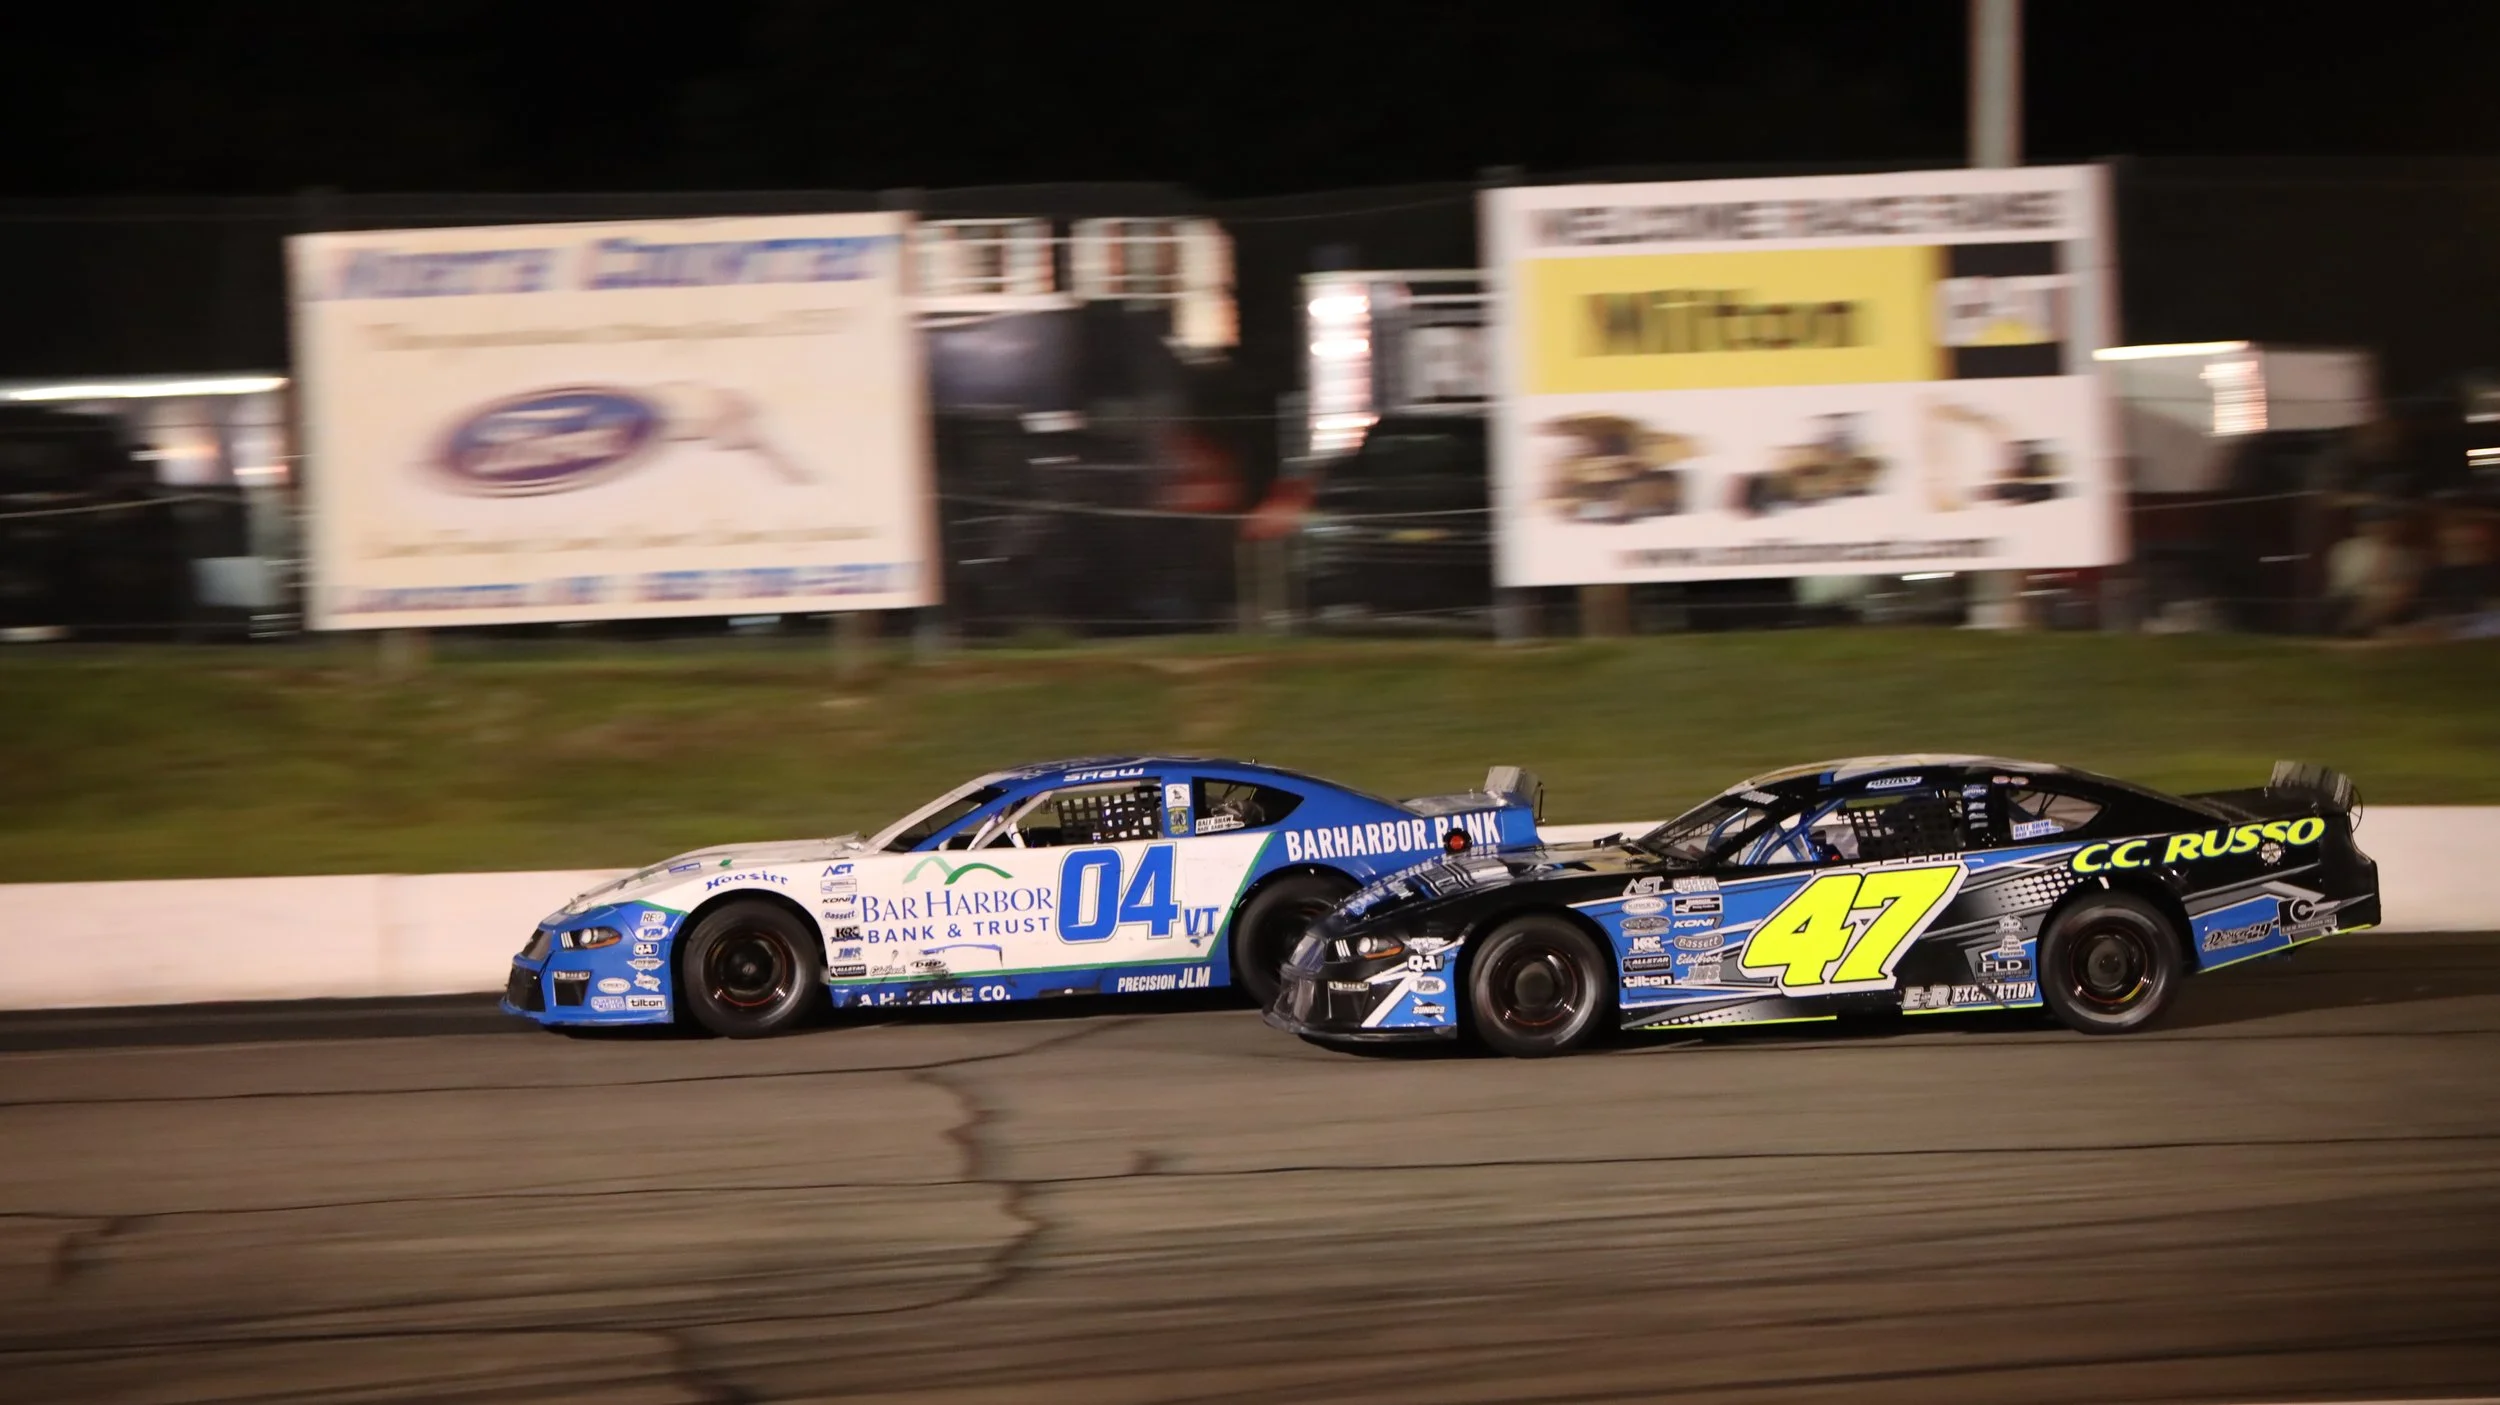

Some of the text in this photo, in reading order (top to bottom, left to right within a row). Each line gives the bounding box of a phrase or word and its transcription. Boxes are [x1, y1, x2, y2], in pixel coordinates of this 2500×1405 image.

[2072, 817, 2325, 873] C.C. RUSSO
[822, 863, 855, 878] ACT
[706, 870, 789, 891] Hoosier
[1622, 876, 1664, 896] ACT
[1059, 844, 1179, 942] 04
[861, 887, 1054, 923] BAR HARBOR
[868, 917, 1050, 944] BANK & TRUST
[1741, 863, 1962, 989] 47
[1678, 937, 1719, 949] Bassett
[1408, 955, 1443, 972] QA1
[1632, 957, 1669, 965] ALLSTAR
[1982, 959, 2023, 972] FLD
[1118, 966, 1211, 993] PRECISION JLM
[1623, 975, 1672, 988] tilton
[979, 985, 1011, 1001] CO.
[631, 999, 663, 1008] tilton
[1412, 1005, 1445, 1015] SUNOCO
